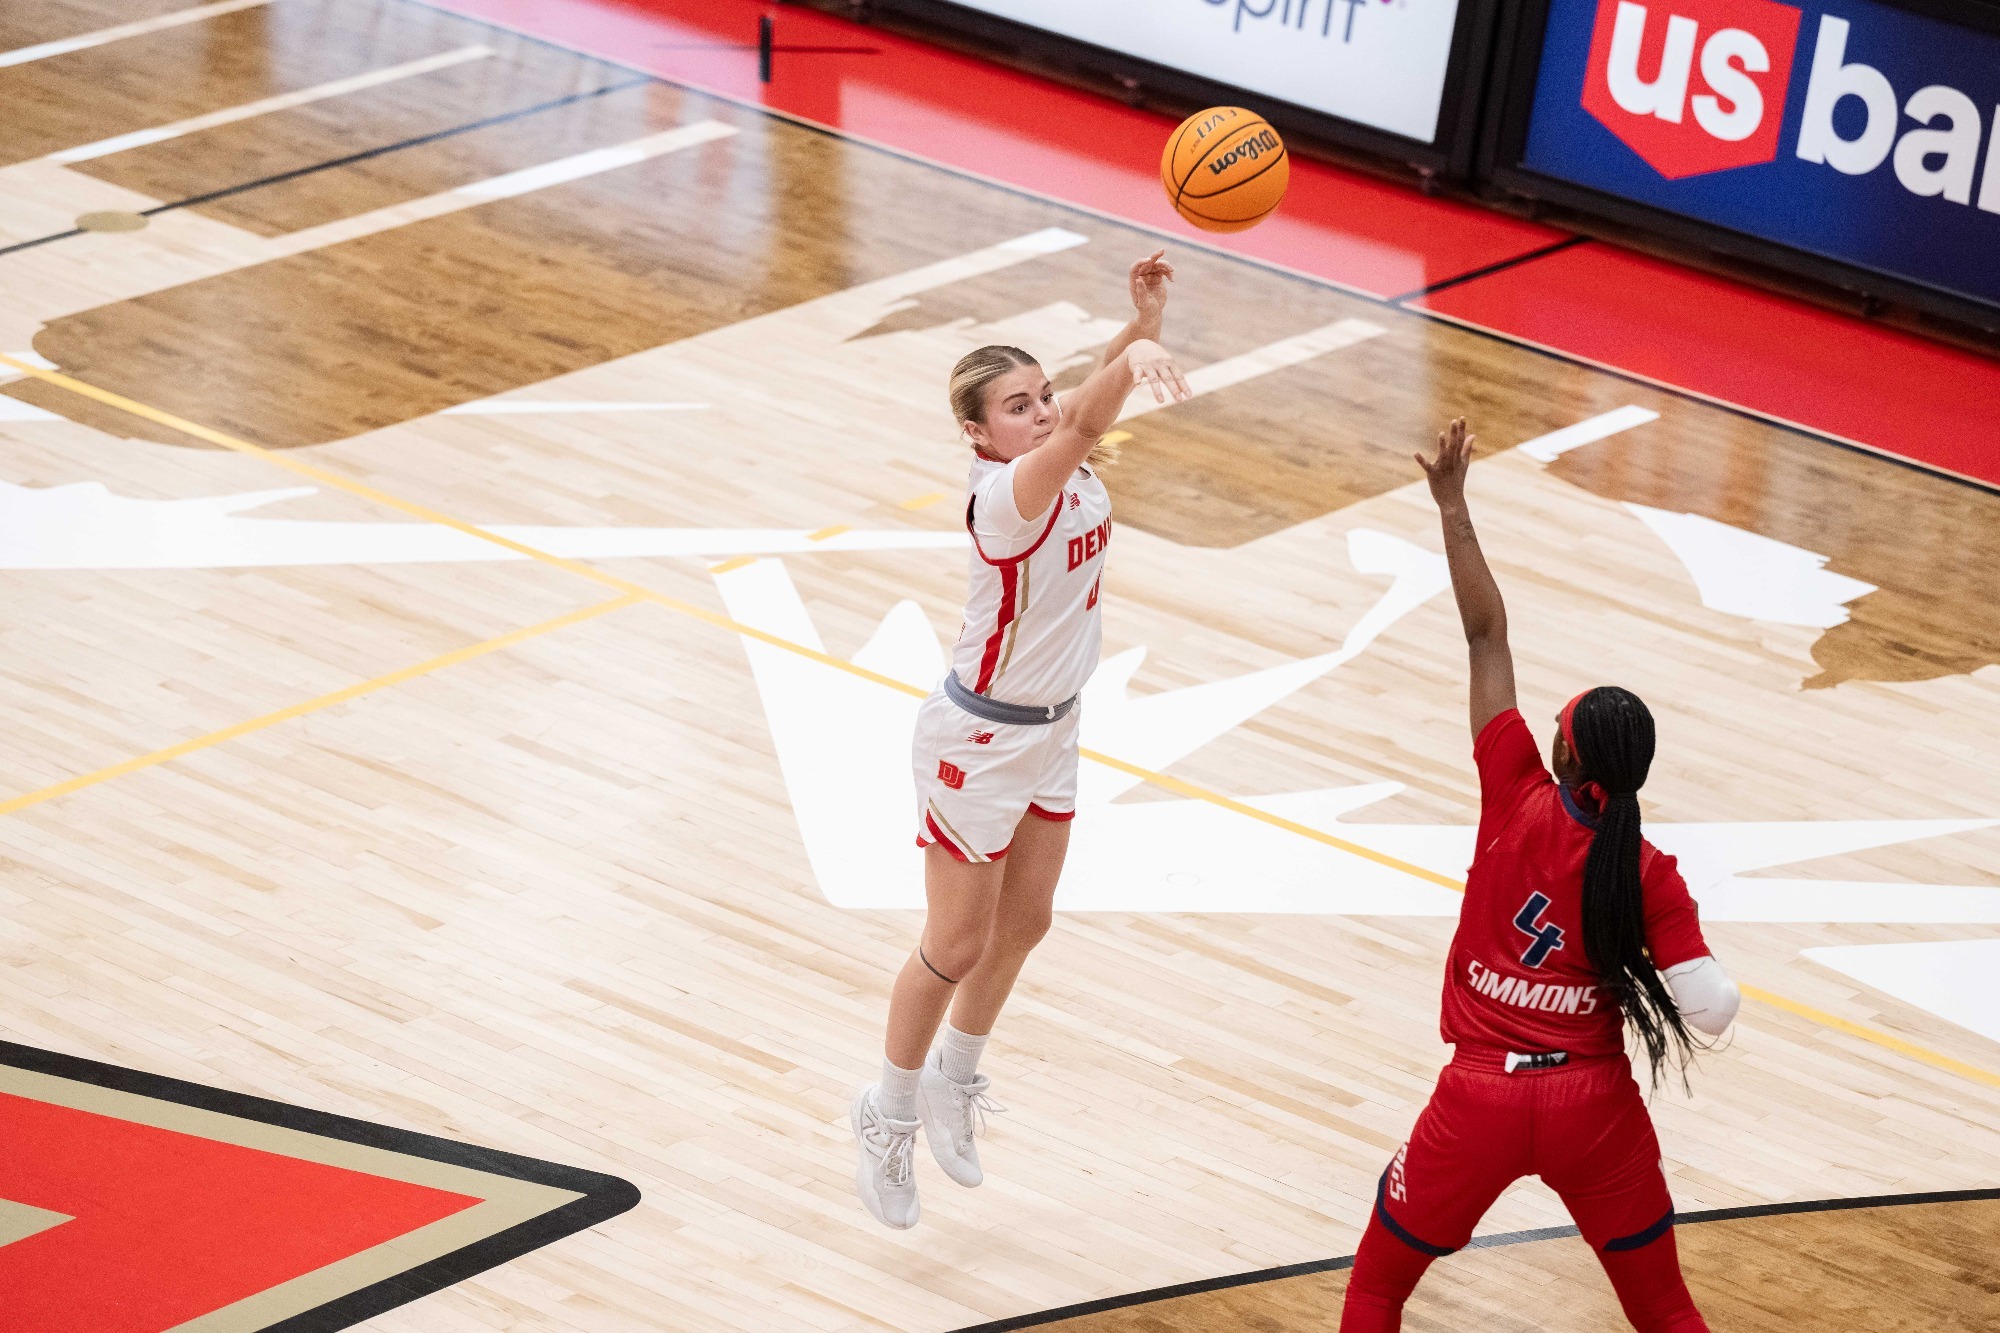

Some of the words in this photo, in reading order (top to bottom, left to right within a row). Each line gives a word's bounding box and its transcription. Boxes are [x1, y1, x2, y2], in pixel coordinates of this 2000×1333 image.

[1606, 0, 1770, 141] us
[1796, 13, 2000, 215] ba
[1208, 129, 1279, 175] Wilson
[1513, 890, 1565, 969] 4
[1467, 959, 1598, 1015] SIMMONS
